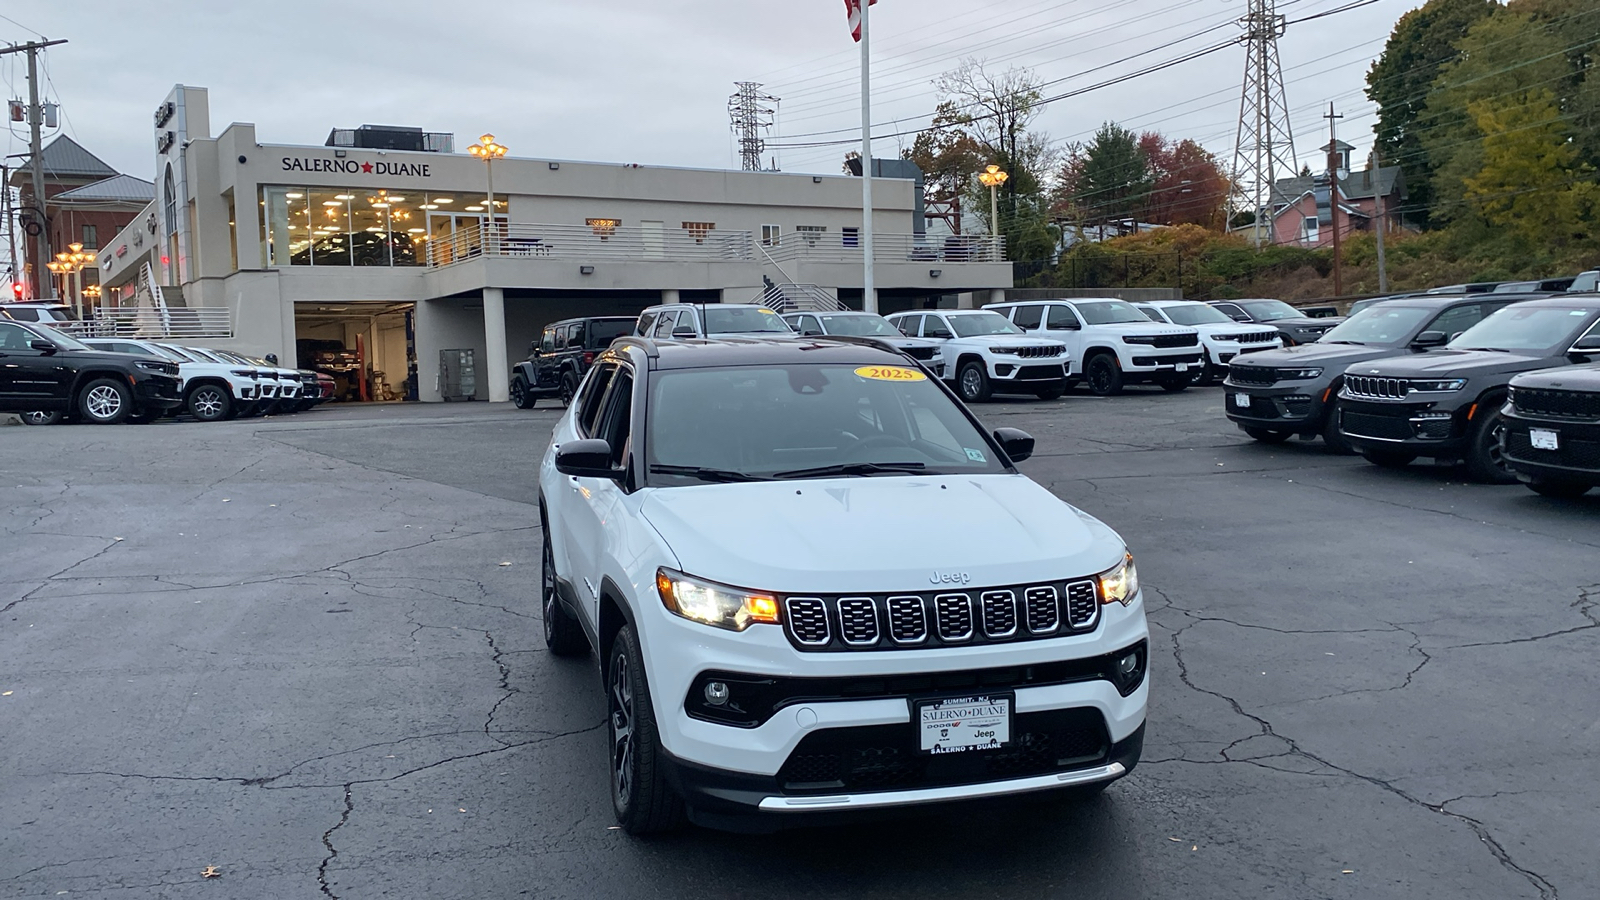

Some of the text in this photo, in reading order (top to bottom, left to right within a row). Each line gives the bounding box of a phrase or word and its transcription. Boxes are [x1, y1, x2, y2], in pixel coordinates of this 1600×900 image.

[282, 157, 431, 177] SALERNO DUANE
[869, 368, 913, 379] 2025
[929, 570, 971, 585] Jeep
[922, 709, 967, 721] SALERNO
[972, 706, 1006, 717] DUANE
[974, 730, 995, 738] Jeep
[930, 742, 1002, 755] SALERNO DUANE
